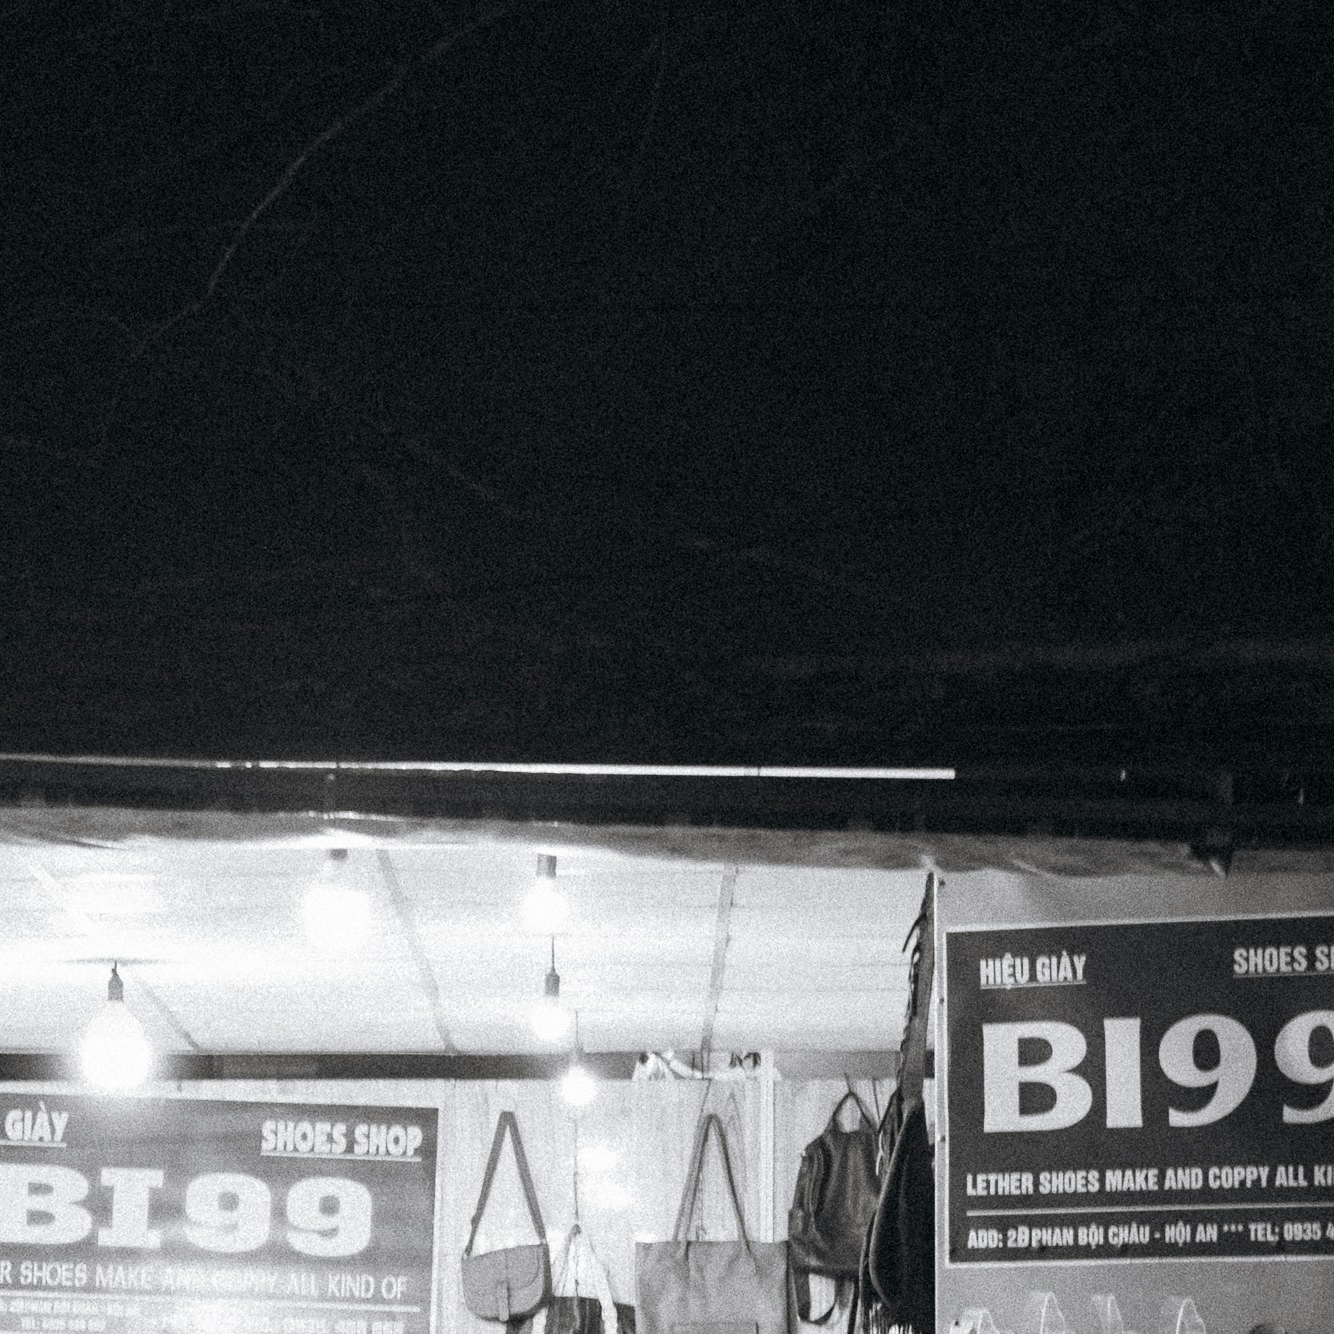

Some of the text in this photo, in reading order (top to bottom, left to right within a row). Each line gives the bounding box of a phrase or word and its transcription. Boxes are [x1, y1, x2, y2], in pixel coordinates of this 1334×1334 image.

[979, 949, 1087, 989] HIỆU GIÀY
[1232, 945, 1308, 975] SHOES
[4, 1100, 70, 1143] GIÀY
[261, 1118, 424, 1157] SHOES SHOP
[966, 1172, 1034, 1197] LETHER
[1038, 1169, 1100, 1195] SHOES
[1105, 1167, 1159, 1193] MAKE
[1163, 1166, 1204, 1190] AND
[1208, 1165, 1270, 1189] COPPY
[1275, 1164, 1308, 1188] ALL
[967, 1227, 1004, 1249] ADD:
[1031, 1225, 1074, 1248] PHAN
[1195, 1221, 1218, 1244] AN
[1248, 1220, 1280, 1243] TEL:
[1283, 1220, 1321, 1242] 0935
[19, 1260, 88, 1287] SHOES
[95, 1264, 153, 1290] MAKE
[285, 1272, 319, 1297] ALL
[327, 1274, 375, 1299] KIND
[381, 1276, 408, 1300] OF
